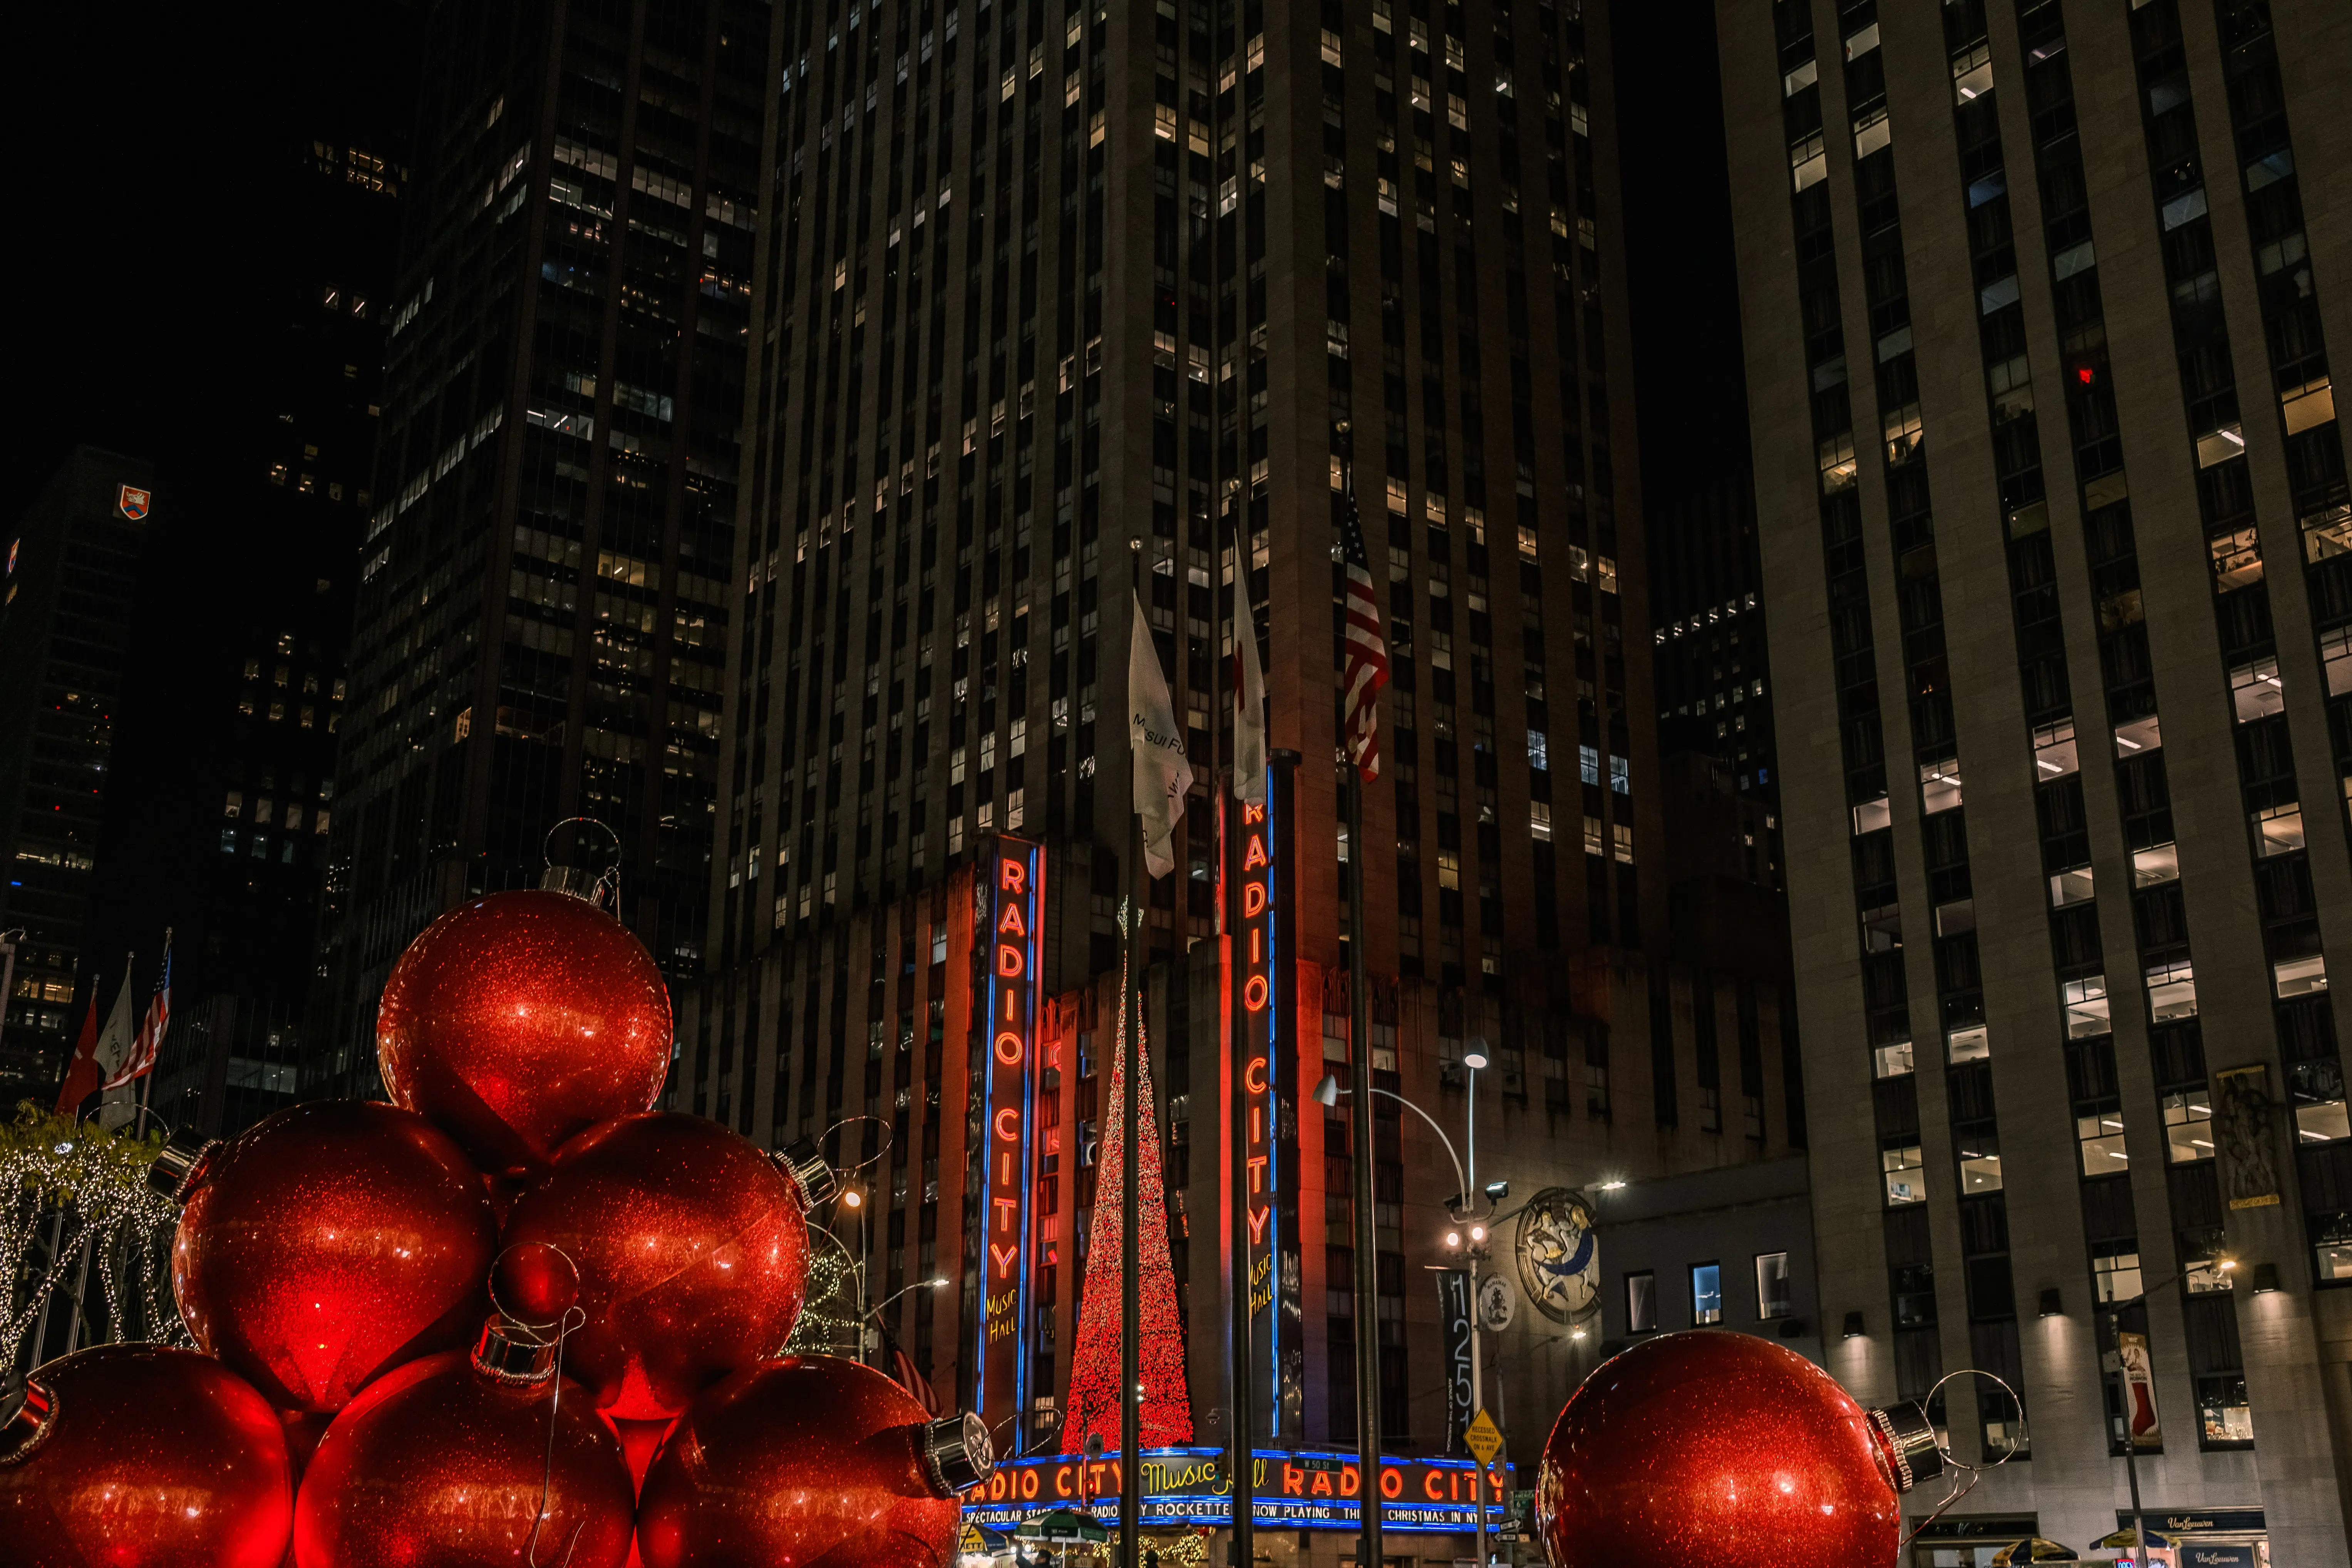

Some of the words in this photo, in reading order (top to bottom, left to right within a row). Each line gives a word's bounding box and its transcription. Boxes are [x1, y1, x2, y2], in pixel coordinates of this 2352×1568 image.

[1133, 713, 1167, 746] MSUI
[1245, 803, 1268, 1011] RADIO
[995, 859, 1024, 1065] RADIO
[1246, 1057, 1269, 1244] CITY
[990, 1107, 1019, 1278] CITY
[987, 1289, 1016, 1320] MUSIC
[1250, 1283, 1272, 1319] HALL
[990, 1316, 1016, 1345] HALL
[1471, 1434, 1497, 1443] CROSSWALK
[1472, 1426, 1495, 1434] RECESSED
[1312, 1461, 1320, 1469] 50
[960, 1468, 1039, 1503] ADIO
[1141, 1462, 1216, 1494] Music
[1283, 1463, 1403, 1498] RADO
[1425, 1469, 1504, 1501] CITY
[967, 1509, 1021, 1523] SPECTACULAR
[1091, 1505, 1118, 1518] RADIO
[1253, 1505, 1277, 1517] NOW
[1284, 1506, 1329, 1518] PLAYING
[1388, 1509, 1444, 1522] CHRISTMAS
[1451, 1511, 1460, 1523] IN
